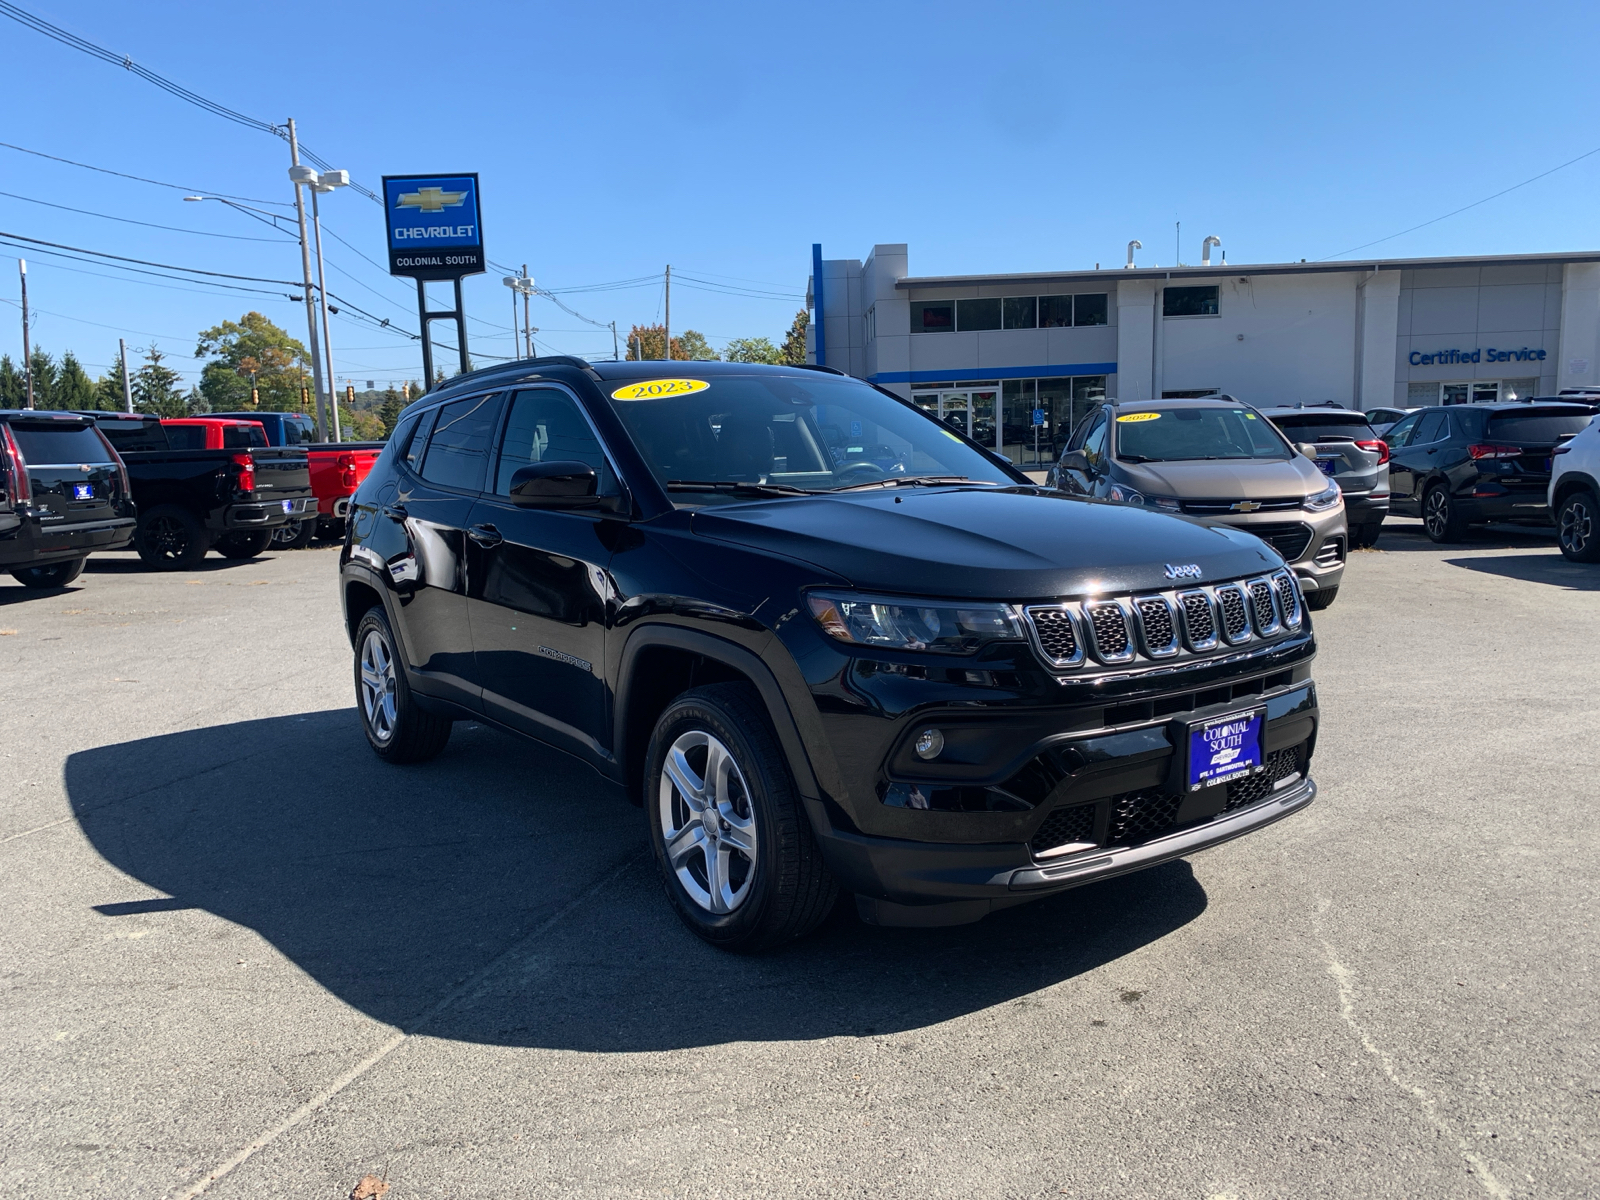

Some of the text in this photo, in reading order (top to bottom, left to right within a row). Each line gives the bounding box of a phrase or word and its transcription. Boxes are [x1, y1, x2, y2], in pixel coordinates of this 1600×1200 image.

[394, 225, 474, 240] CHEVROLET
[396, 255, 477, 267] COLONIAL SOUTH
[1409, 347, 1547, 366] Certified Service
[631, 381, 693, 398] 2023
[1125, 414, 1153, 422] 2021
[1163, 563, 1202, 580] Jeep
[538, 645, 592, 672] COMPASS
[1203, 721, 1249, 742] COLONIAL
[1210, 733, 1242, 752] SOUTH
[1213, 750, 1238, 762] CHEVROLET
[1206, 774, 1232, 787] COLONIAL
